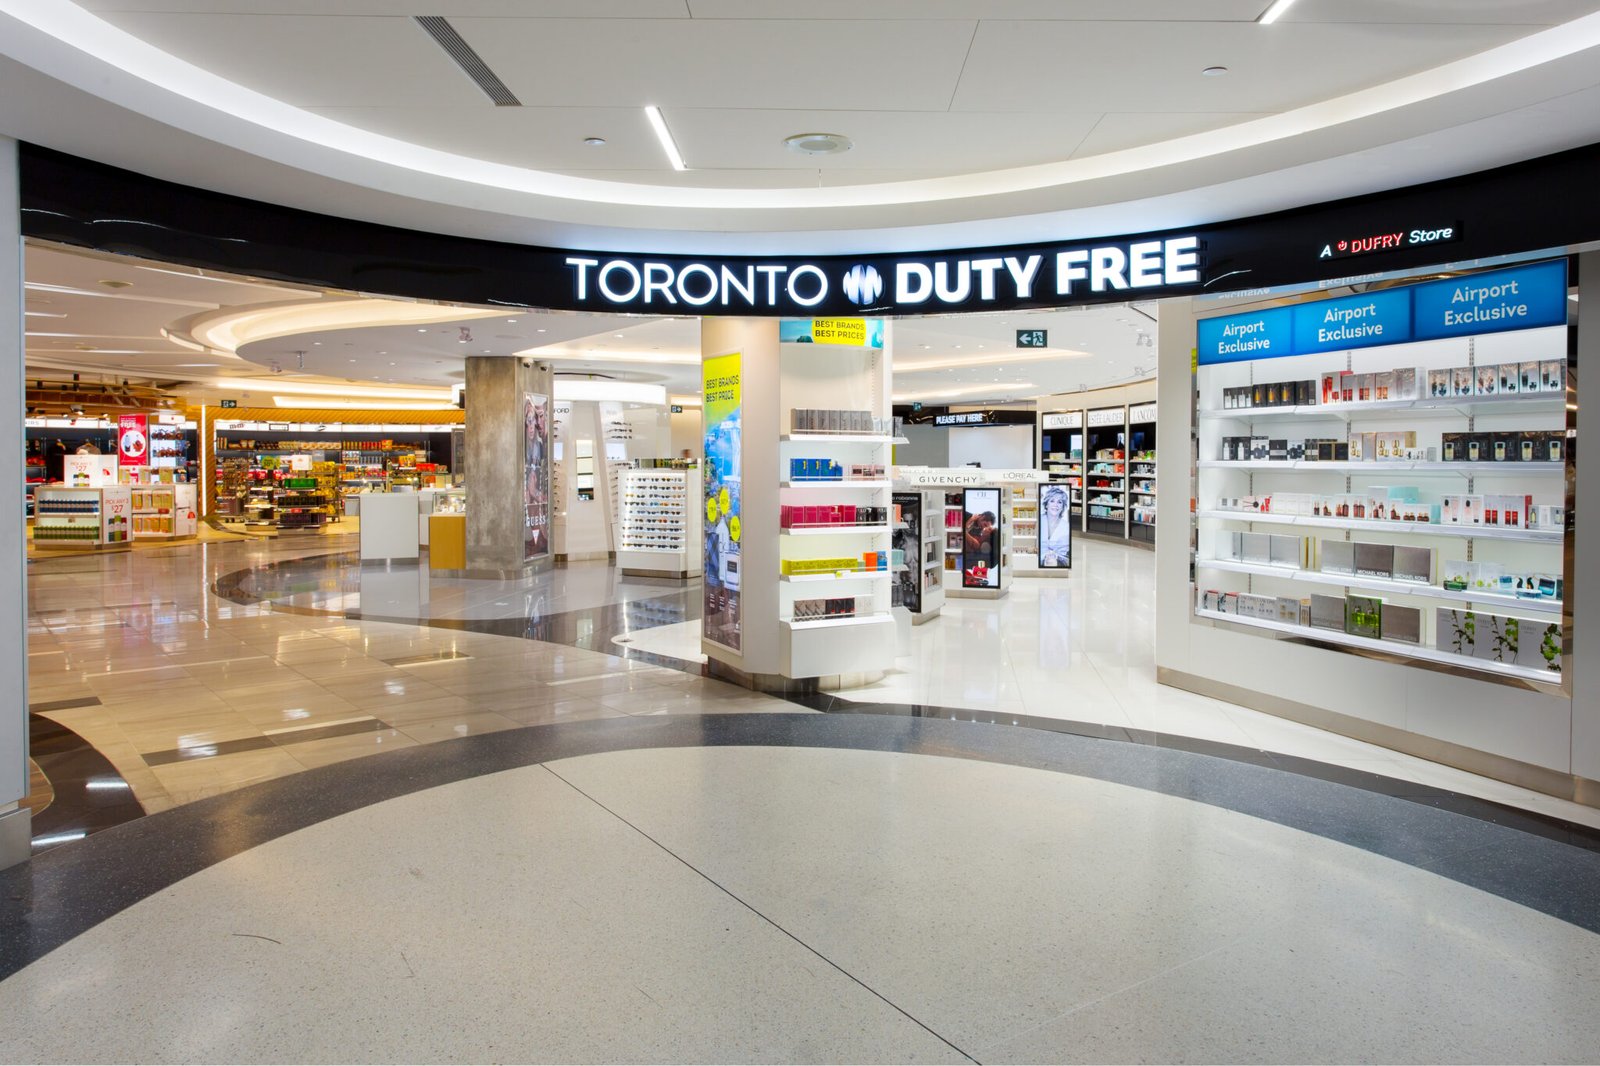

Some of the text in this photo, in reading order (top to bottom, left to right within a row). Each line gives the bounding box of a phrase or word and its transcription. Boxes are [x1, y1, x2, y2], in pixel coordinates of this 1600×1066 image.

[1319, 227, 1453, 258] A DUFRY Store
[565, 236, 1199, 306] TORONTO DUTY FREE
[1453, 280, 1519, 305] Airport
[1324, 303, 1377, 324] Airport
[1444, 303, 1528, 326] Exclusive
[836, 321, 865, 330] BRANDS
[1222, 320, 1266, 338] Airport
[815, 329, 865, 339] BEST PRICES
[1318, 323, 1384, 343] Exclusive
[1218, 337, 1271, 355] Exclusive
[706, 374, 740, 389] BEST BRANDS
[706, 389, 734, 403] BEST PRICE
[935, 413, 983, 425] PLEASE PAY HERE
[1050, 415, 1073, 426] CLINIQUE
[1103, 412, 1123, 424] LAUDER
[919, 475, 978, 483] GIVENCHY
[111, 504, 124, 513] $27
[526, 514, 546, 527] GUESS
[1357, 569, 1377, 577] MICHAEL
